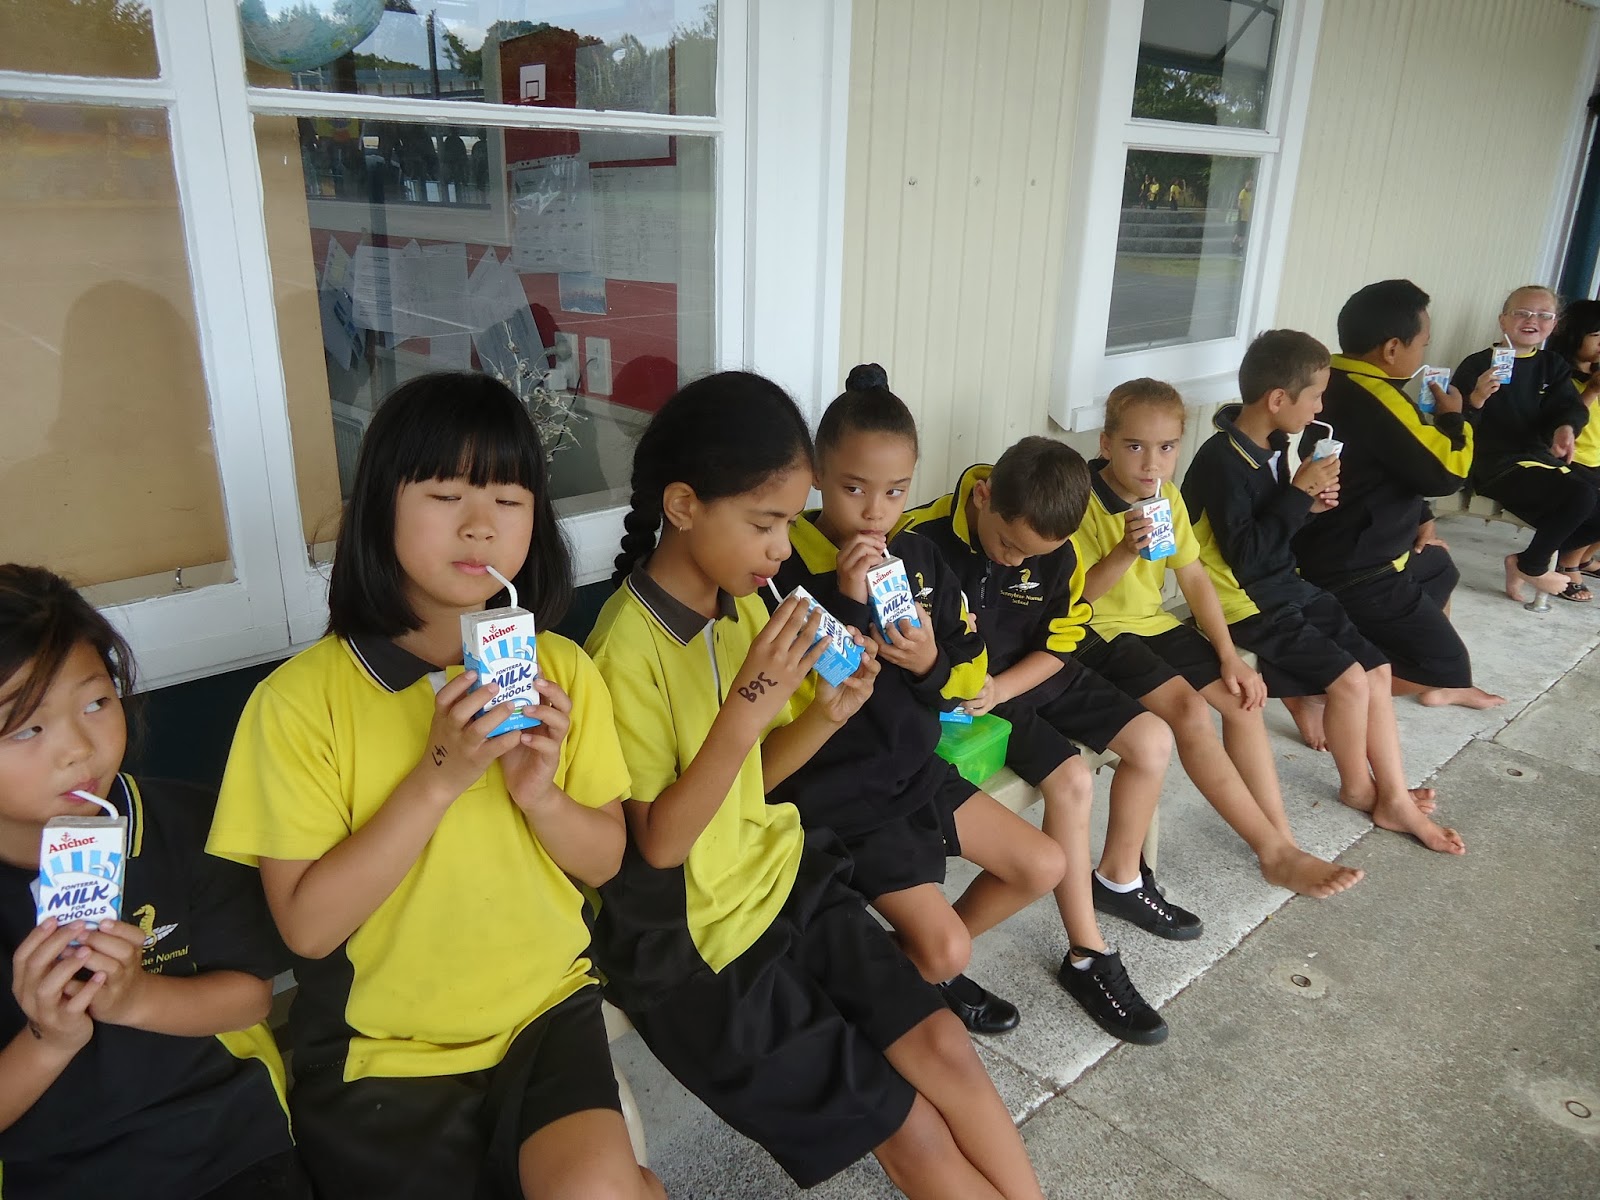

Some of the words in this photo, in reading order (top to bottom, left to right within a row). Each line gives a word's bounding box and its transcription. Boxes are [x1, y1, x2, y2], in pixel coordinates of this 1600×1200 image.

[1151, 524, 1170, 539] MILK
[872, 570, 892, 586] Anchor
[883, 592, 909, 617] MILK
[886, 605, 911, 623] SCHOOLS
[482, 624, 516, 646] Anchor
[496, 662, 523, 676] FONTERRA
[491, 683, 532, 706] SCHOOLS
[49, 835, 96, 854] Anchor
[61, 880, 99, 892] FONTERRA
[47, 883, 110, 912] MILK
[54, 906, 107, 922] CHOOLS
[156, 945, 190, 963] Normal
